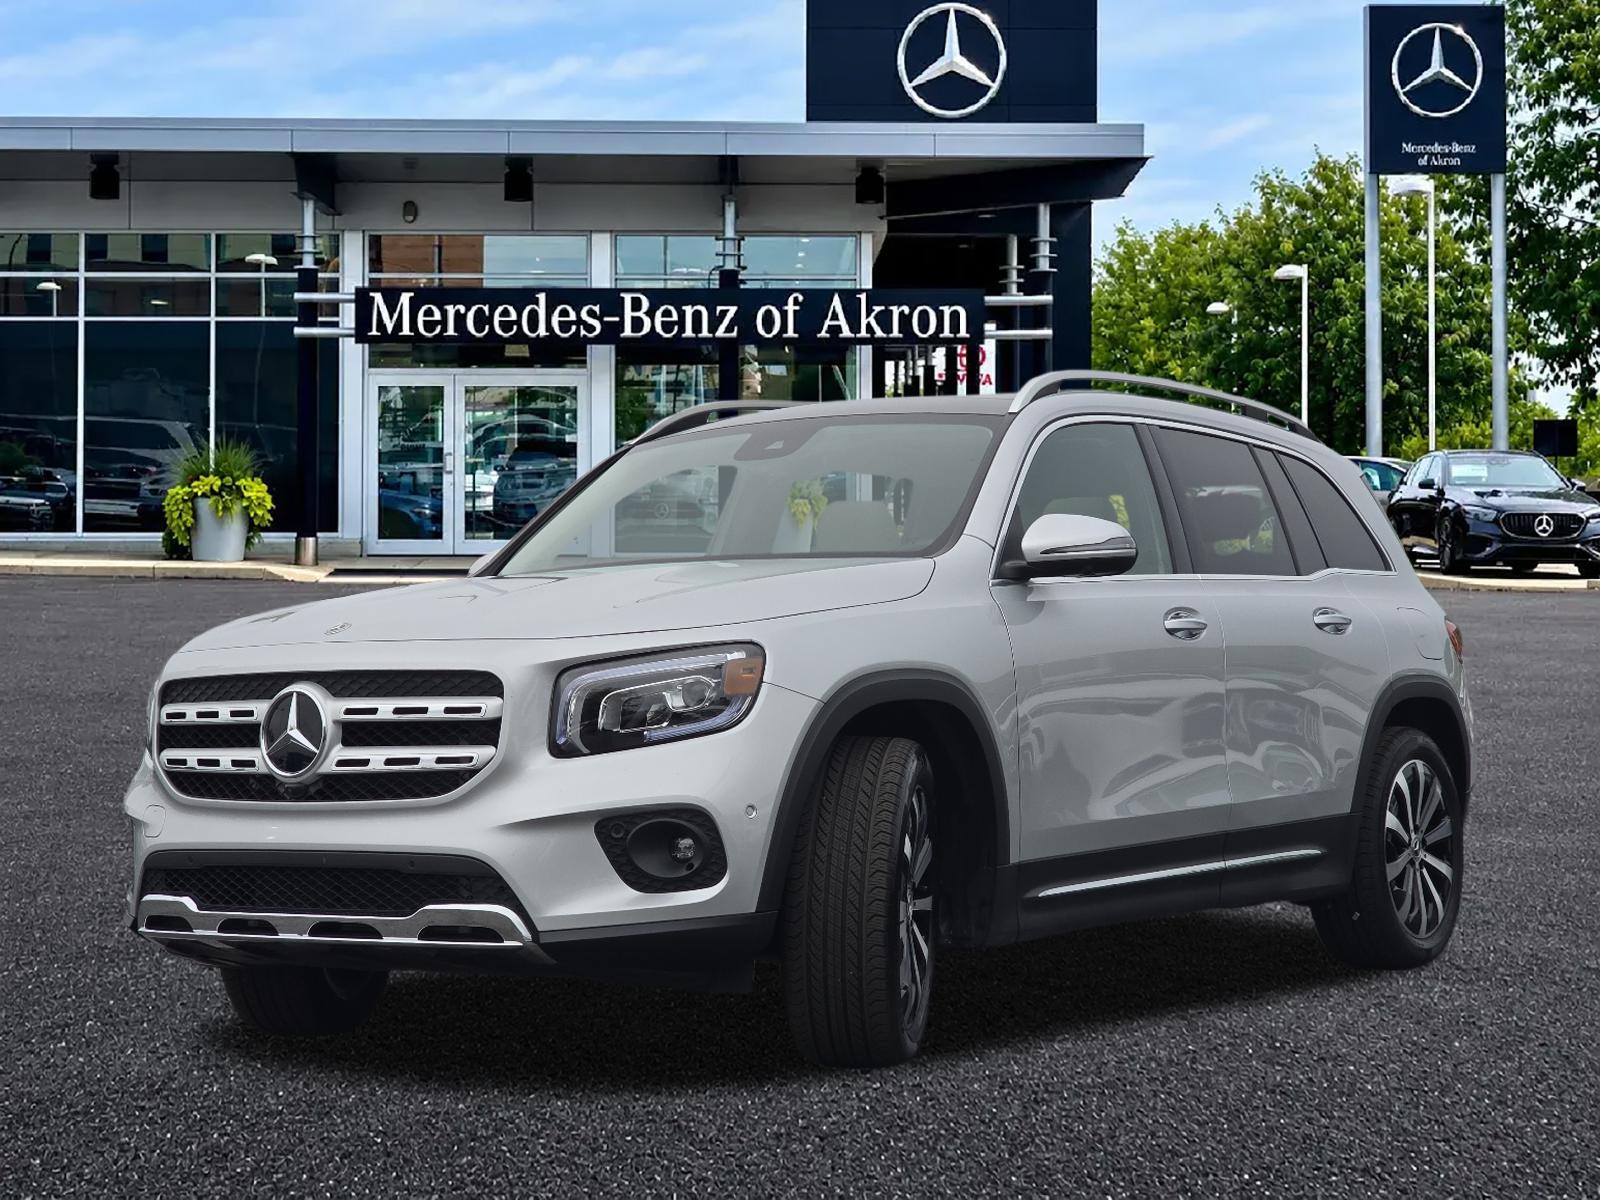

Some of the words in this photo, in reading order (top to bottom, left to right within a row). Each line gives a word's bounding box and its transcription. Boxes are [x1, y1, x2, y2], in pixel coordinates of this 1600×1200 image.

[1401, 141, 1476, 154] Mercedes-Benz
[1417, 154, 1428, 166] of
[1430, 154, 1461, 166] Akron
[367, 290, 738, 339] Mercedes-Benz
[755, 291, 804, 339] of
[816, 291, 970, 339] Akron
